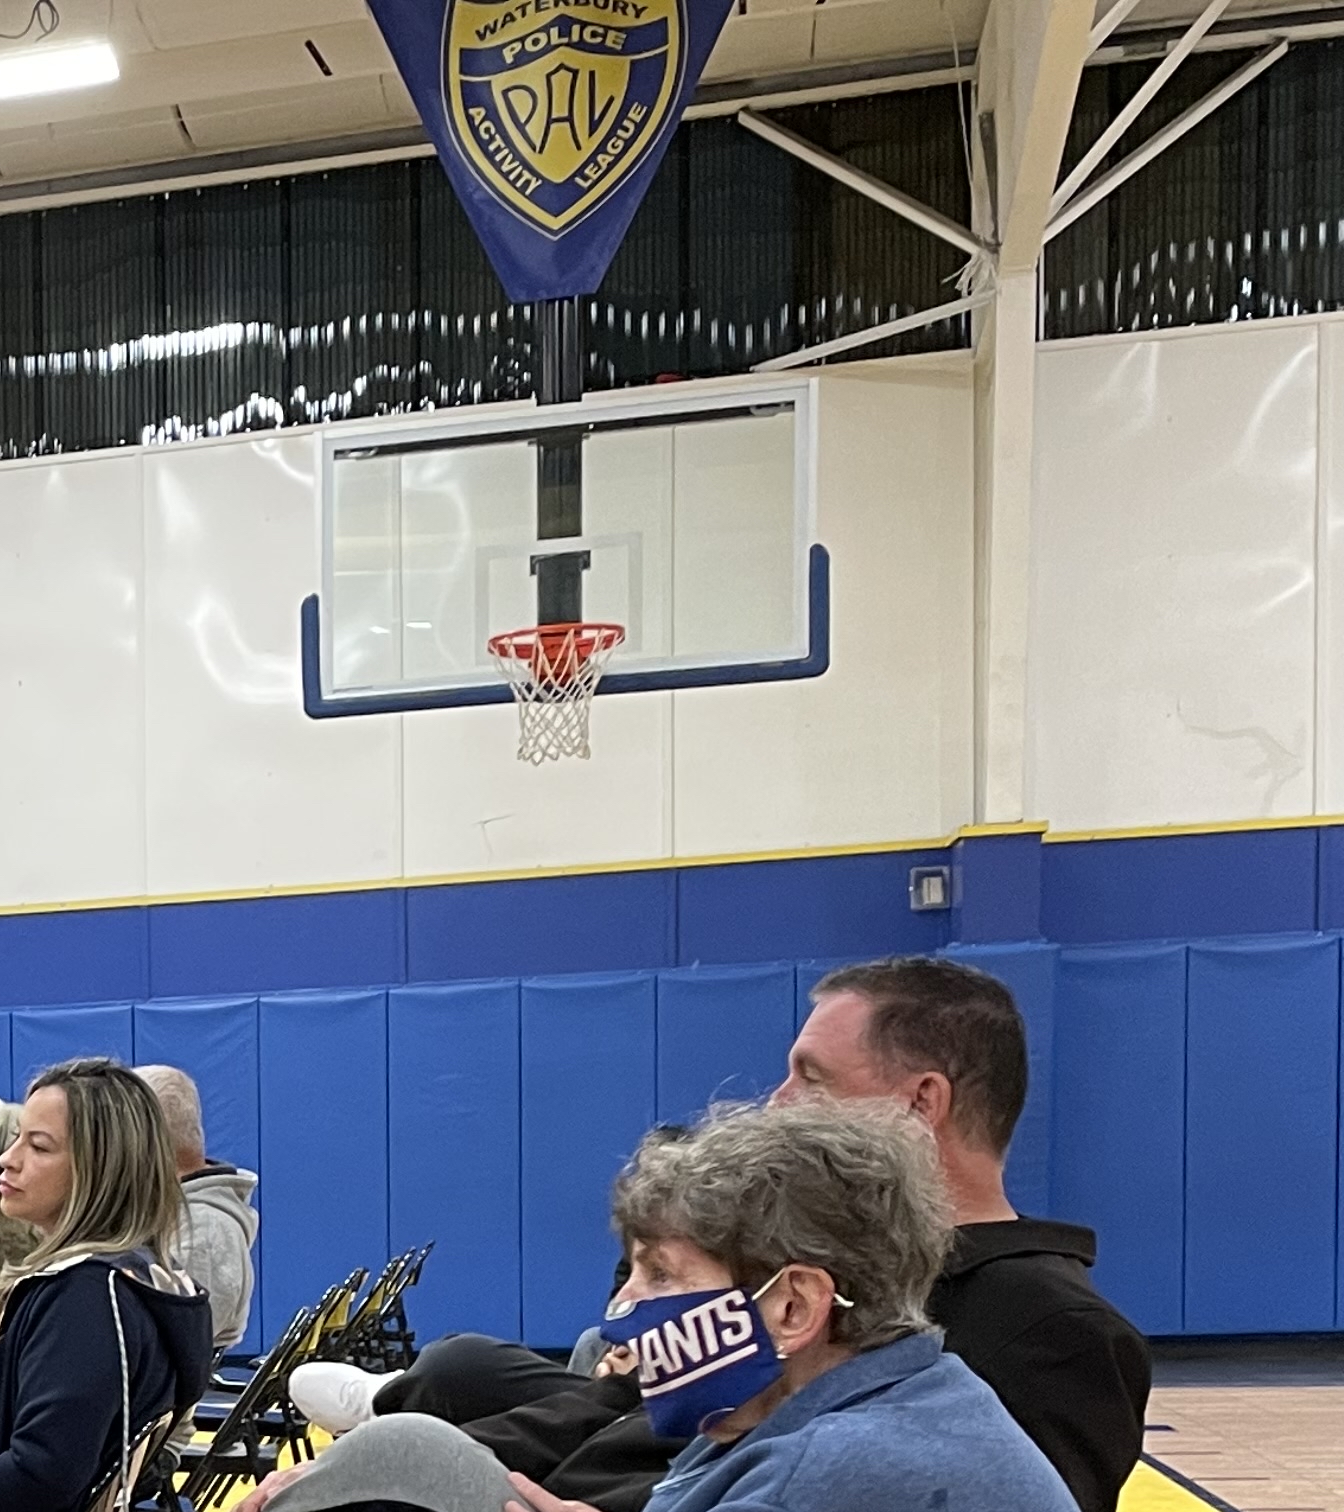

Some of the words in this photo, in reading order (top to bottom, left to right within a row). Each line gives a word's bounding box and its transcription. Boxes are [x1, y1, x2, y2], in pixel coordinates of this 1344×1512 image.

[503, 24, 627, 64] POLICE
[468, 105, 543, 196] ACTIVITY
[574, 101, 648, 190] LEAGUE
